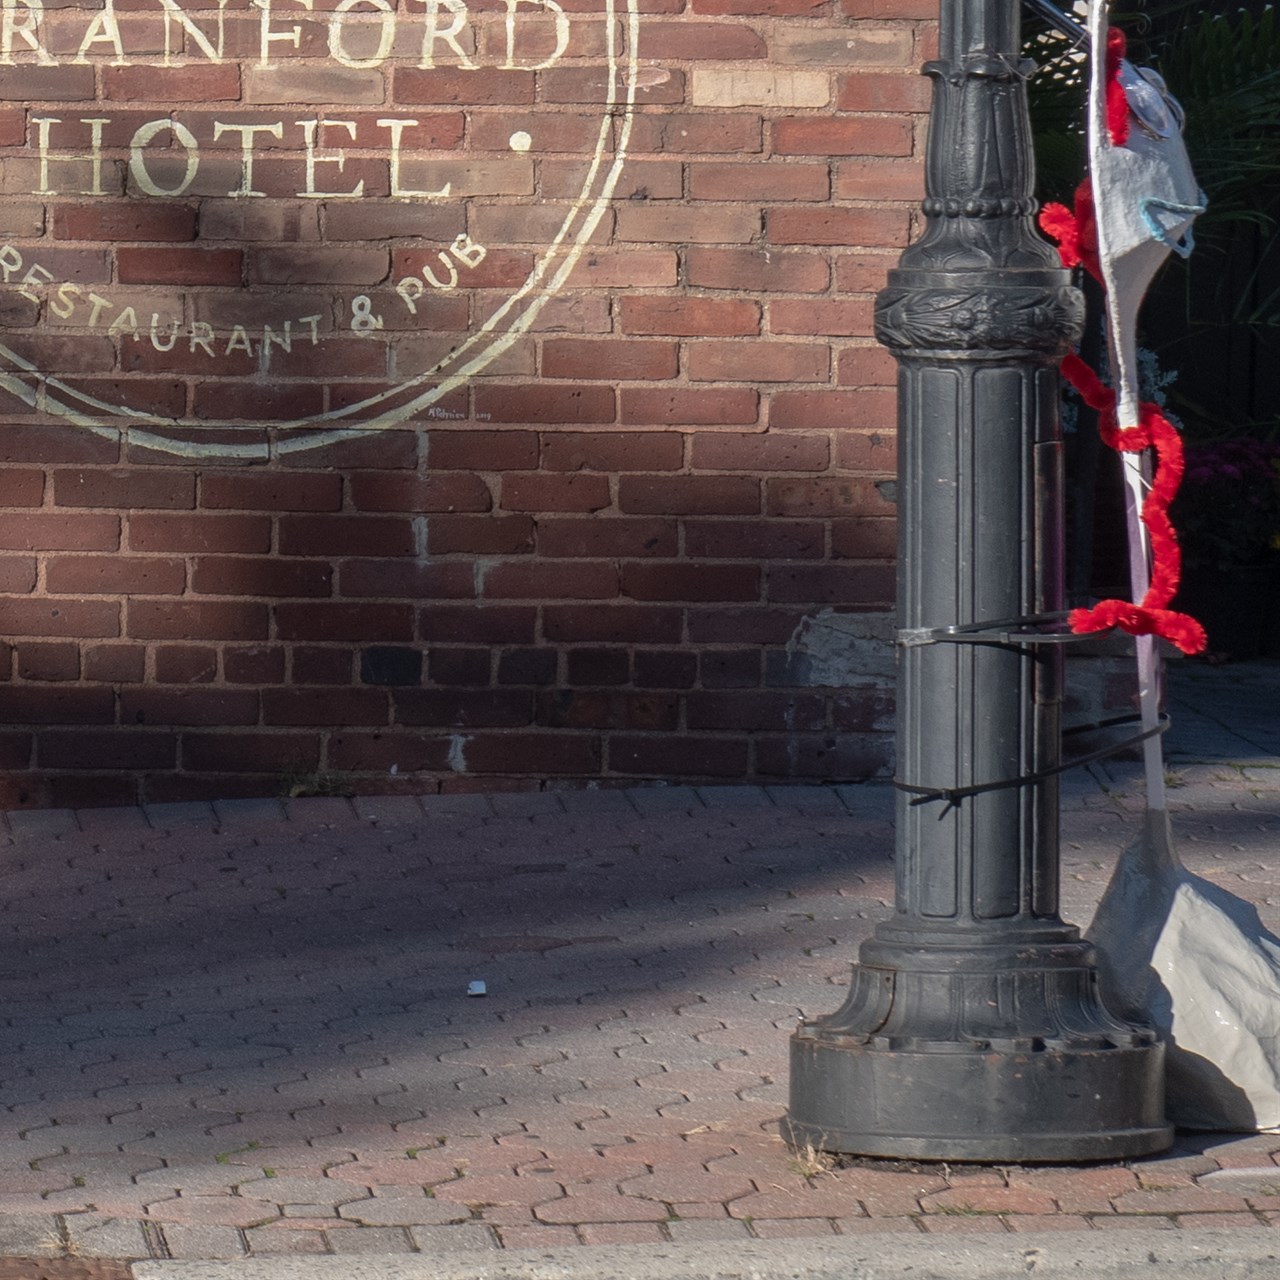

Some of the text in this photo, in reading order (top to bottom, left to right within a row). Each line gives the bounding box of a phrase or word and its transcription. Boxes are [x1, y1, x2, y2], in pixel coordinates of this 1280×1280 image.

[30, 117, 451, 198] HOTEL
[350, 294, 384, 336] &
[394, 232, 488, 315] PUB
